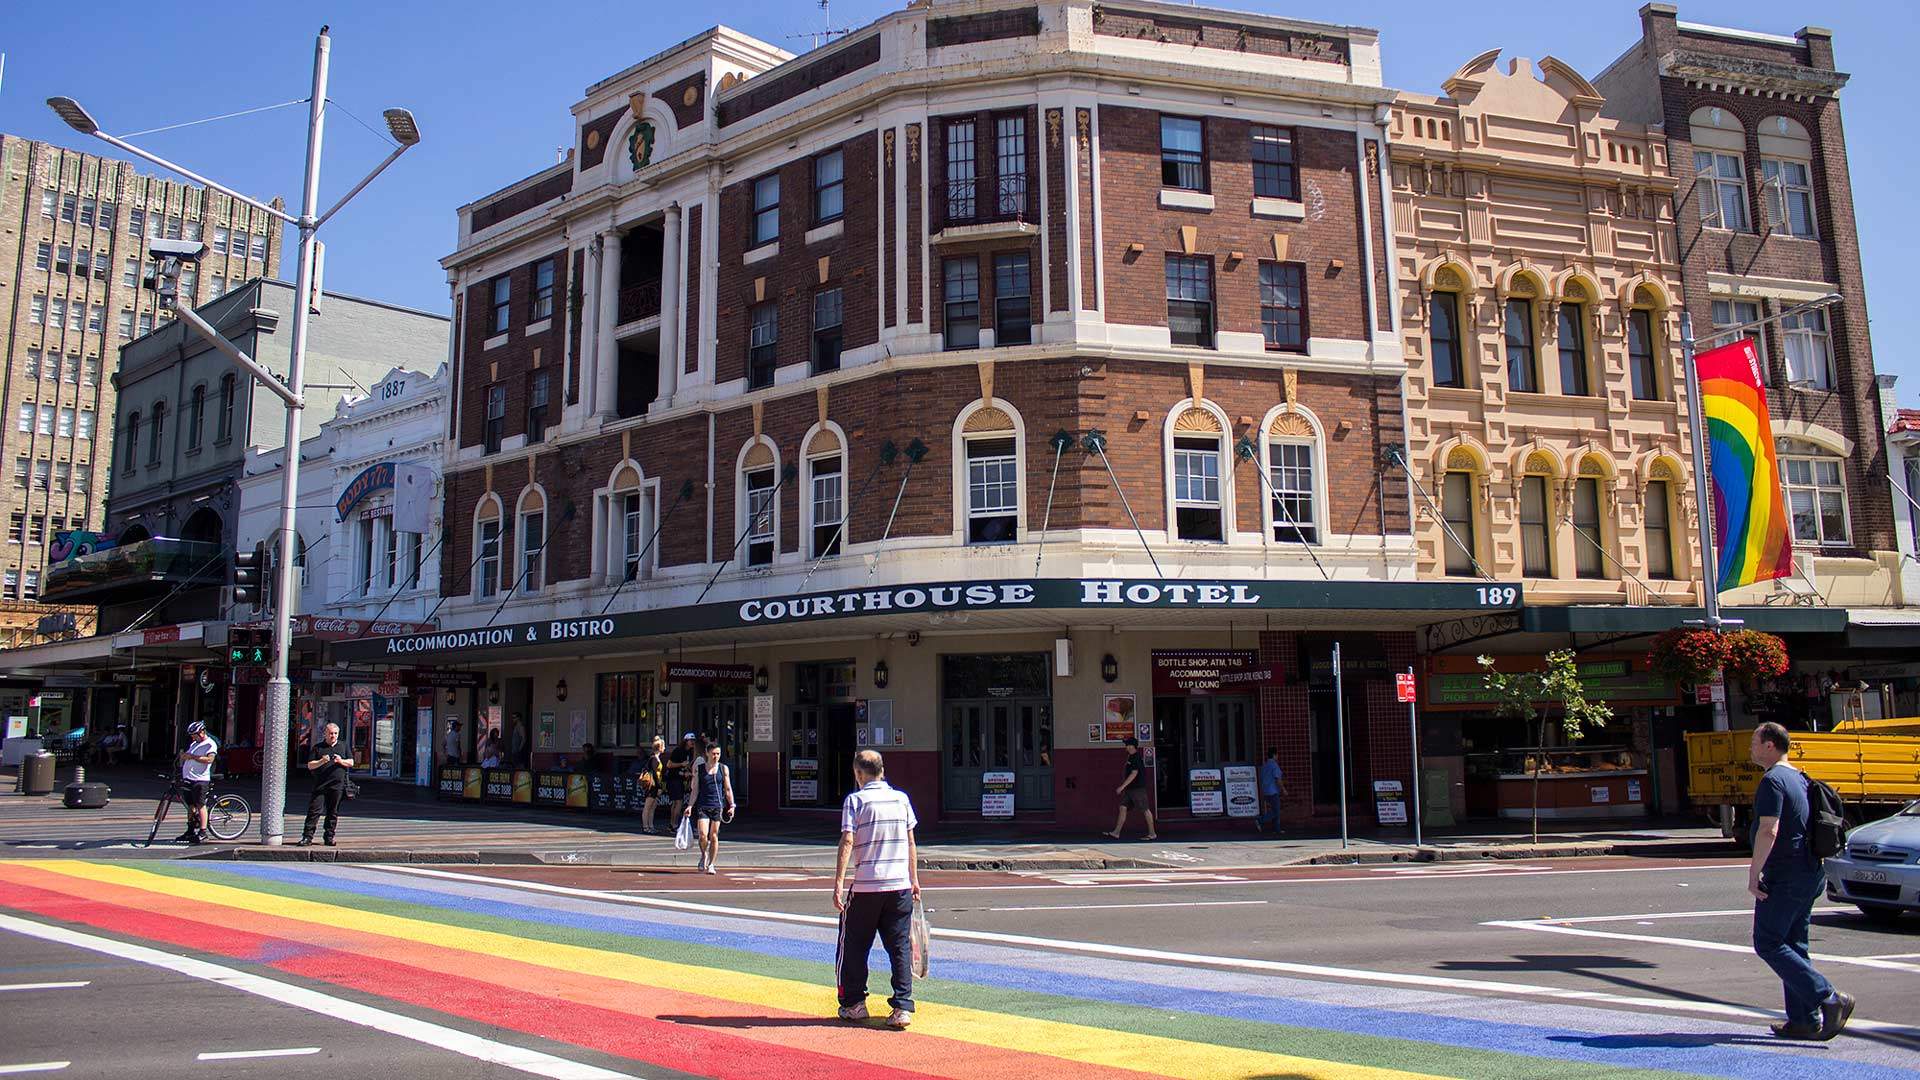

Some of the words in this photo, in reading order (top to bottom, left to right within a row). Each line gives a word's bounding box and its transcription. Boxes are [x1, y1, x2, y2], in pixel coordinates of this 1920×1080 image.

[381, 380, 405, 400] 1887
[739, 584, 1036, 622] COURTHOUSE
[1080, 581, 1261, 605] HOTEL
[1476, 587, 1517, 605] 189
[314, 619, 346, 632] Coca-Cola
[371, 622, 402, 634] Coca-Cola
[386, 628, 513, 654] ACCOMMODATION
[526, 626, 538, 641] &
[550, 619, 614, 639] BISTRO
[1158, 658, 1187, 667] BOTTLE
[669, 667, 718, 679] ACCOMMODATION
[731, 670, 753, 679] LOUNGE
[1169, 669, 1220, 678] ACCOMMODAT
[1195, 680, 1220, 688] LOUNG
[440, 780, 453, 791] SINCE
[487, 783, 500, 795] SINCE
[538, 787, 552, 799] SINCE
